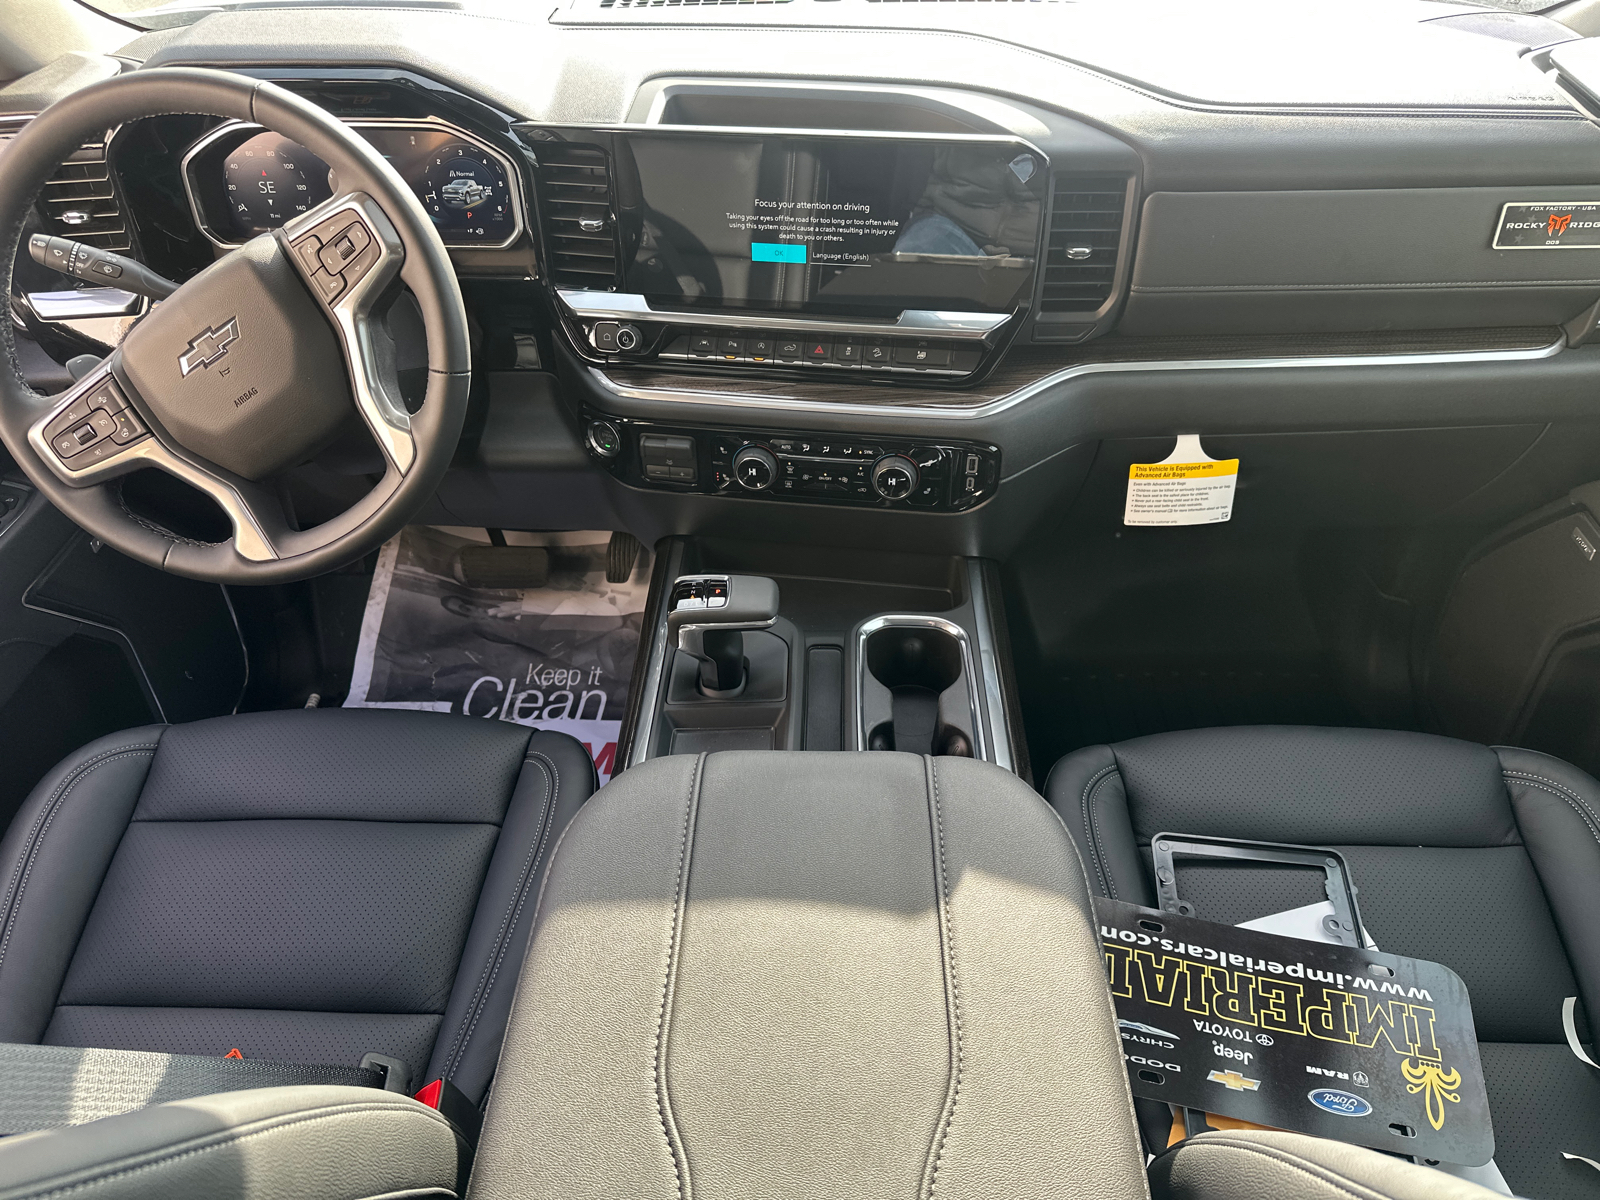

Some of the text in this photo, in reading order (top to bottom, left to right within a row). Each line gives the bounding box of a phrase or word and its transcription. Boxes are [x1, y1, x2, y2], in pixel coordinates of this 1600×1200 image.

[258, 181, 276, 194] SE
[755, 199, 777, 208] Focus
[796, 202, 830, 210] attention
[844, 203, 870, 214] driving
[726, 213, 745, 221] Taking
[832, 218, 844, 226] long
[837, 227, 863, 235] resulting
[813, 252, 869, 261] Language (English)
[234, 387, 258, 408] AIRBAG
[526, 662, 603, 690] Keep it
[462, 676, 608, 721] Clean
[1103, 942, 1442, 1062] IMPERIAL
[1192, 1019, 1253, 1043] TOYOTA
[1213, 1044, 1253, 1065] Jeep
[1306, 1065, 1350, 1080] RAM
[1323, 1092, 1358, 1111] Ford
